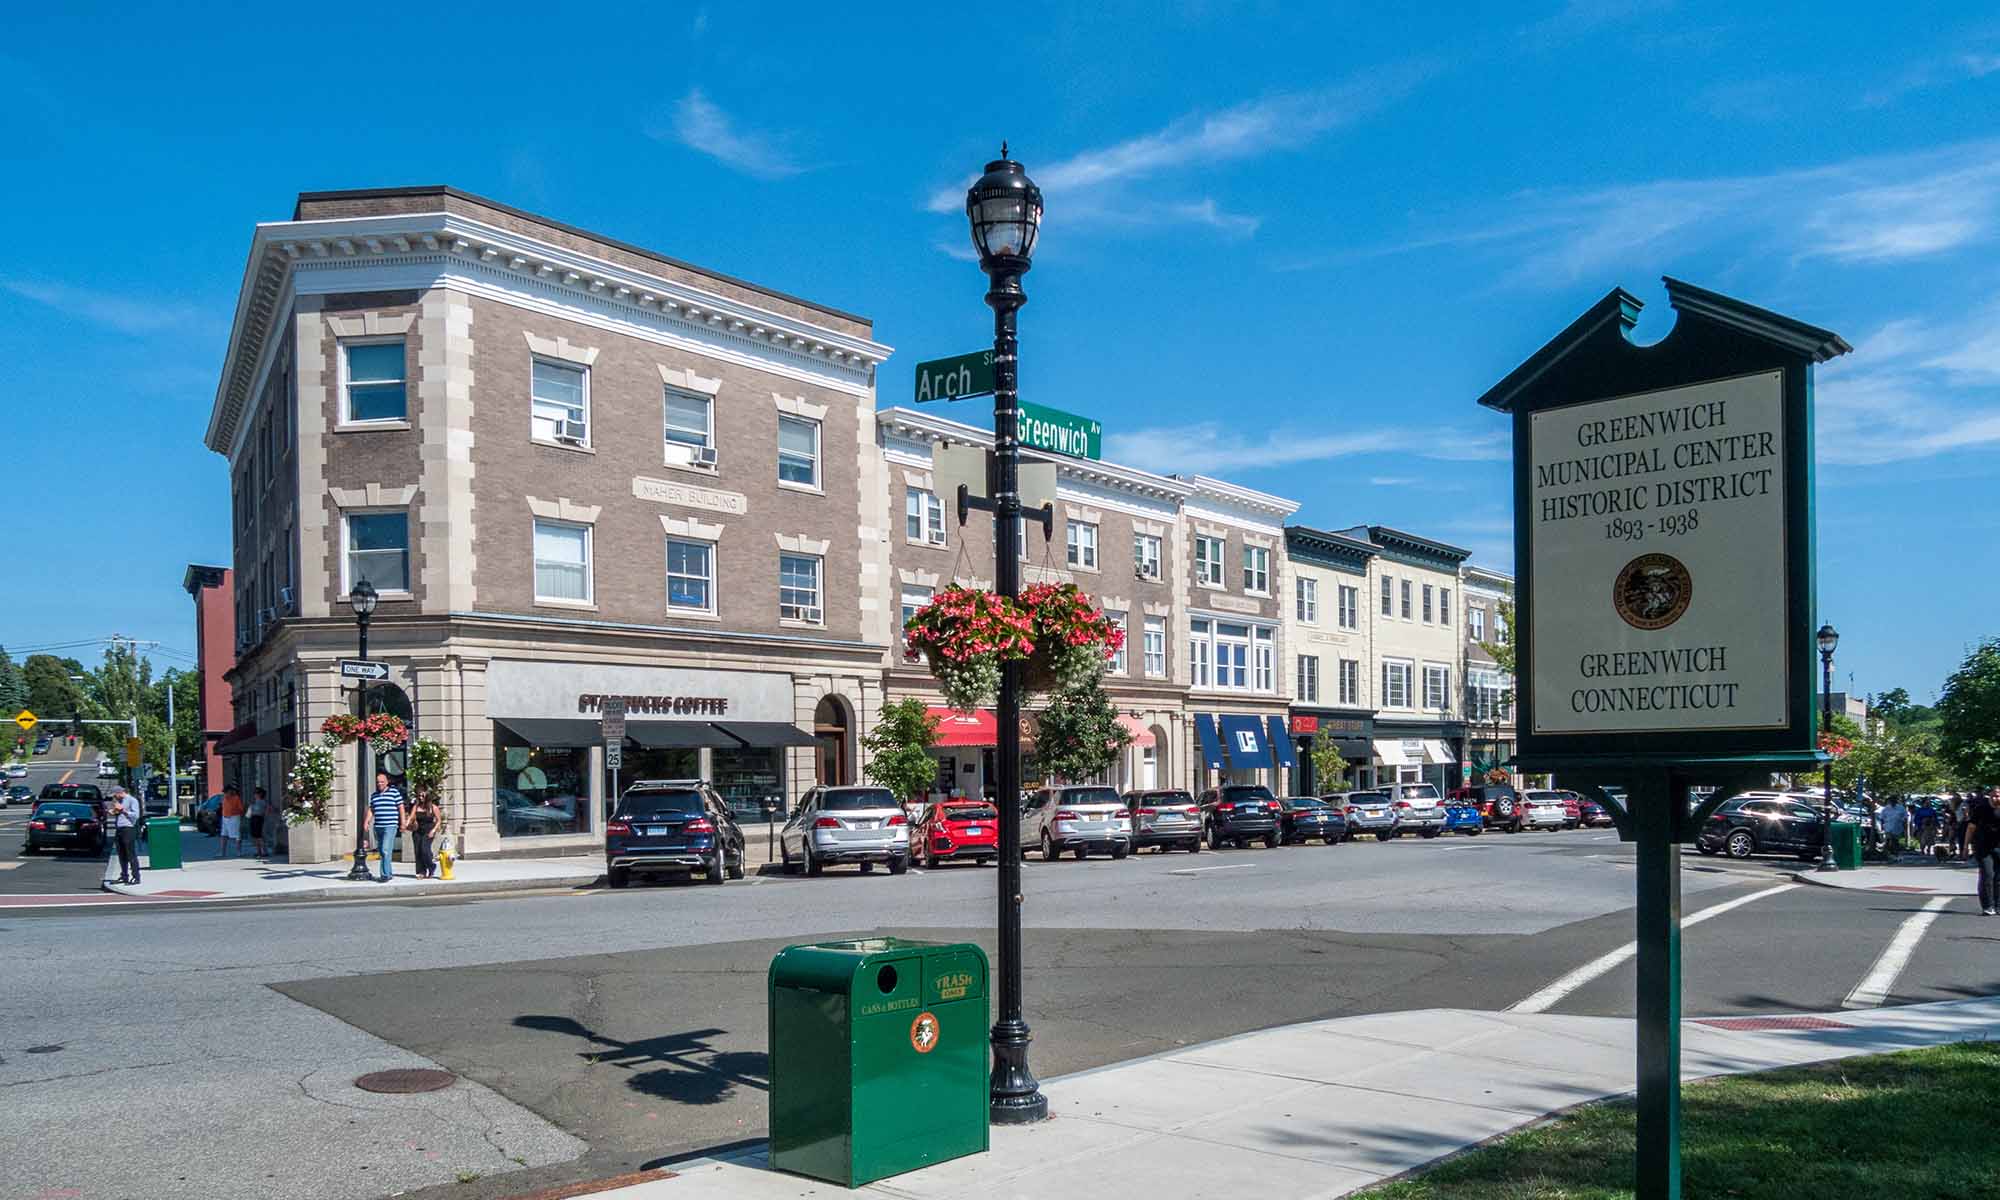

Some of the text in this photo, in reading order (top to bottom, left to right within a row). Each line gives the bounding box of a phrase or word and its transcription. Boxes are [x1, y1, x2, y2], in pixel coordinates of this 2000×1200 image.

[918, 351, 995, 401] Arch St
[1017, 407, 1101, 457] Greenwich Av
[1577, 400, 1727, 448] GREENWICH
[1537, 431, 1776, 489] MUNICIPAL CENTER
[688, 490, 737, 509] BUILDING
[1542, 469, 1772, 522] HISTORIC DISTRICT
[345, 665, 360, 673] ONE
[1580, 646, 1728, 678] GREENWICH
[674, 696, 728, 716] COFFEE
[1571, 683, 1739, 713] CONNECTICUT
[608, 753, 620, 766] 25
[936, 974, 973, 990] TRASH
[887, 998, 919, 1011] BOTTLES
